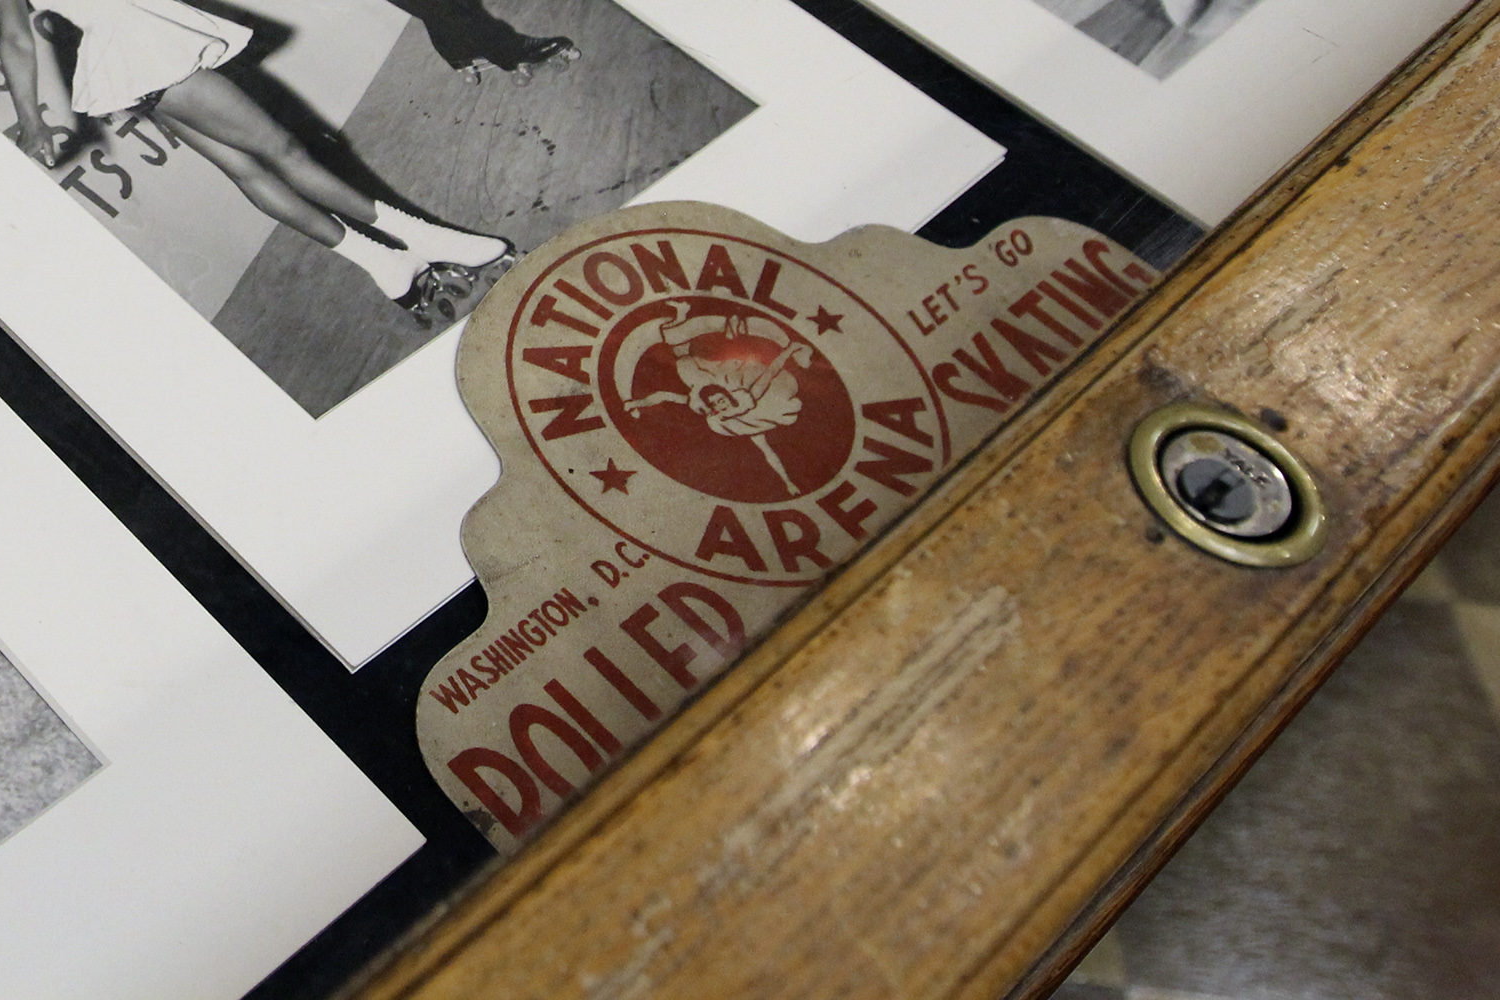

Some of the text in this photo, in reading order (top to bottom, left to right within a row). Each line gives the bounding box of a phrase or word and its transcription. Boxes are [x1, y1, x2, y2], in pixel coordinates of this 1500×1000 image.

[523, 240, 799, 442] NATIONAL
[908, 229, 1034, 337] LET'S GO
[932, 239, 1155, 414] SKATING
[695, 397, 935, 573] ARENA
[429, 541, 651, 715] WASHINGTON, D.C.
